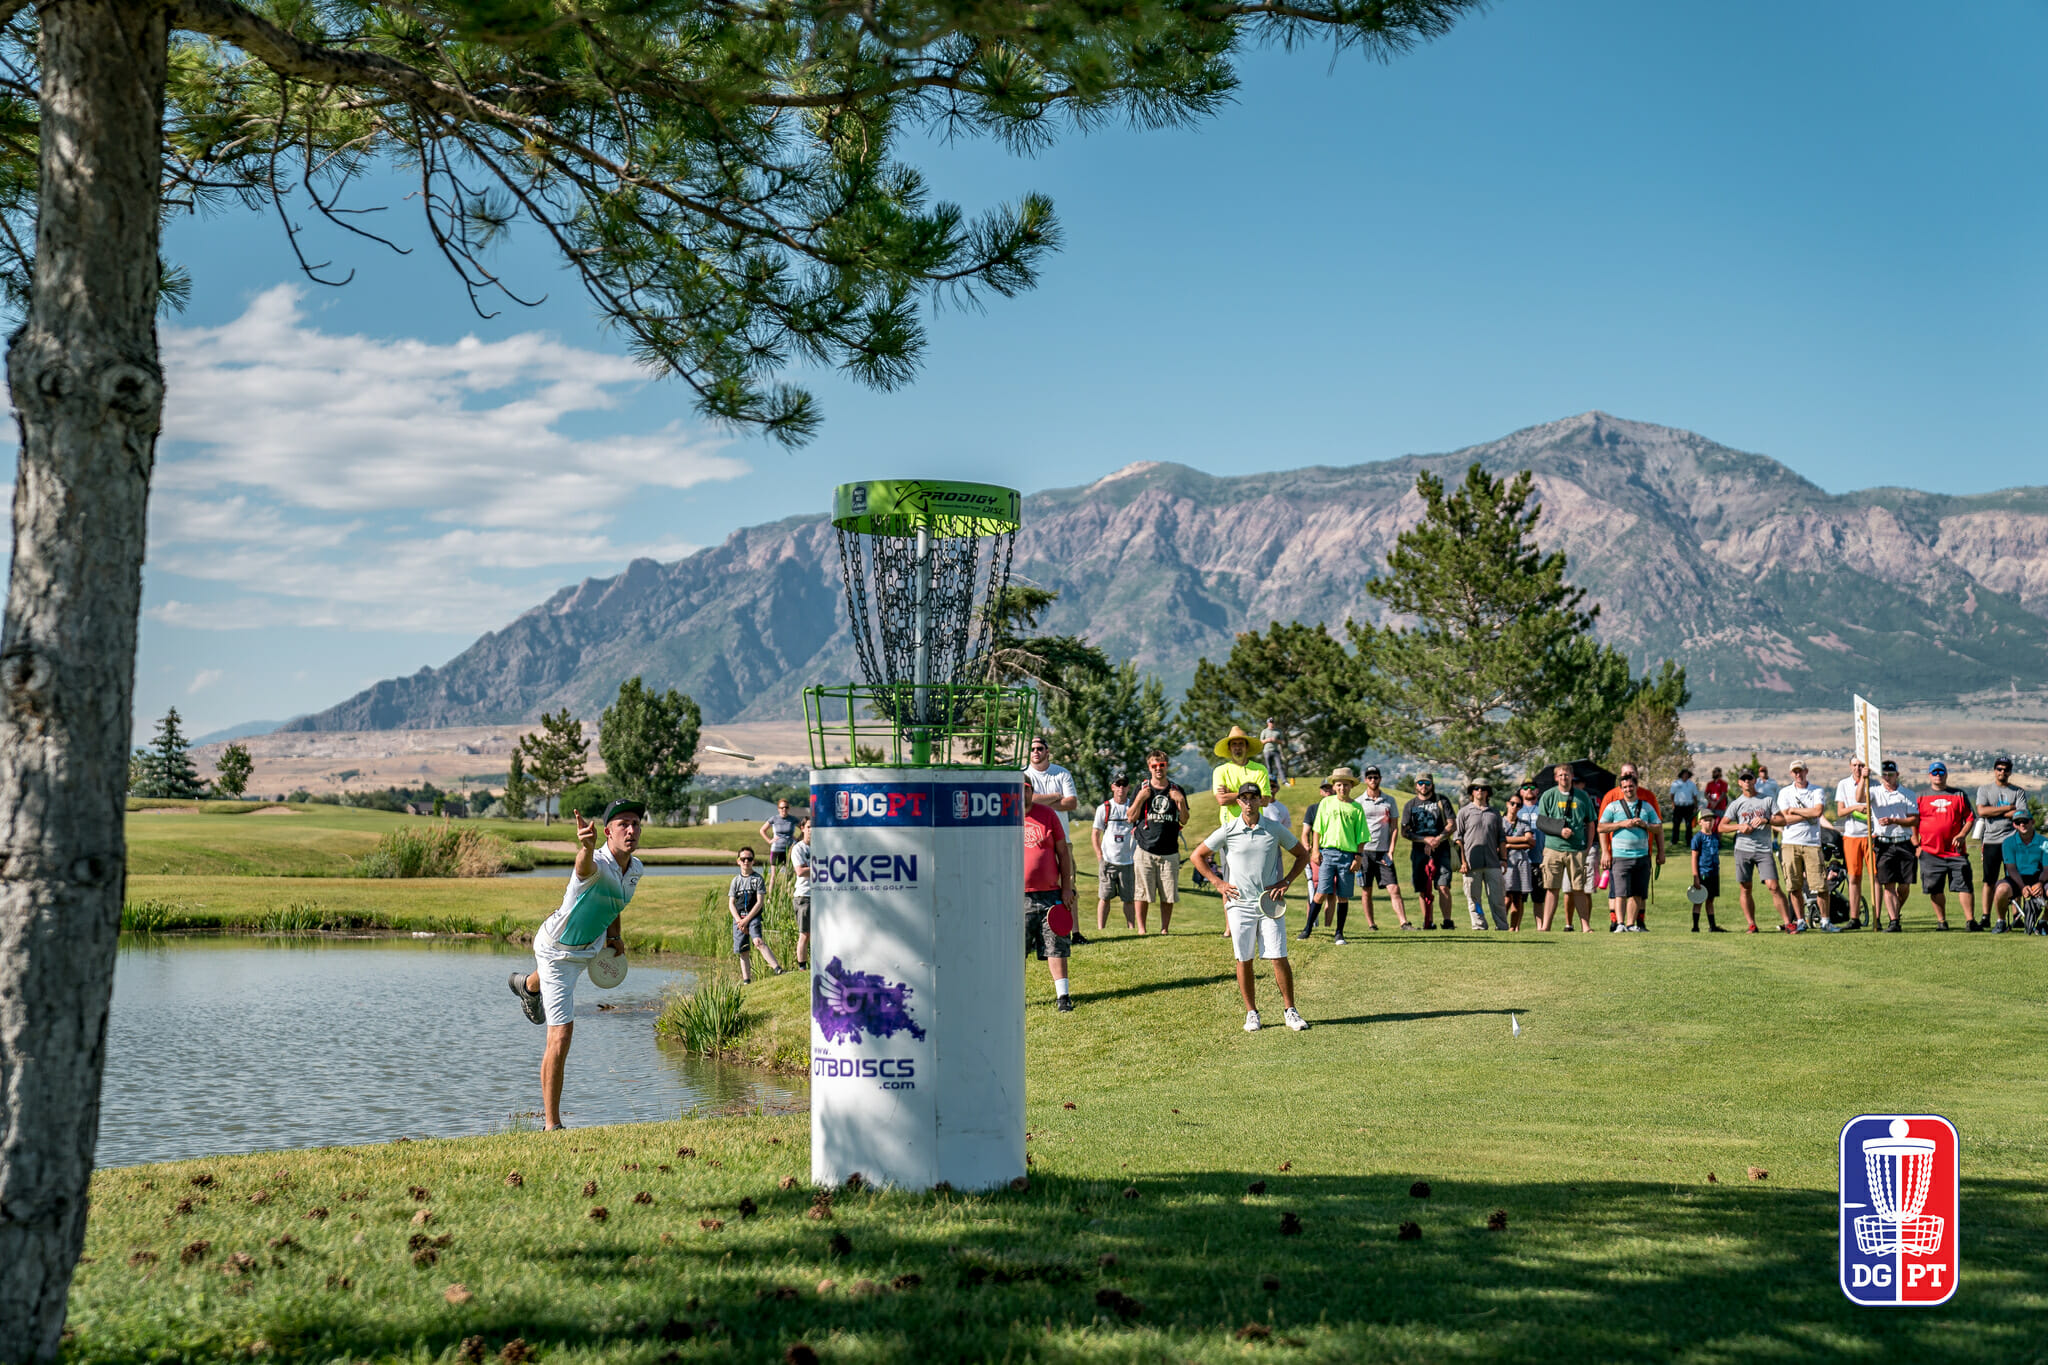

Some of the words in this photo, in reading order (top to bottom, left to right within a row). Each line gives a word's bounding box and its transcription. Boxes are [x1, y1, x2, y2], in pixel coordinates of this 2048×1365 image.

[918, 491, 998, 505] PRODIGY
[982, 505, 1005, 514] DISC
[850, 792, 926, 817] DGPT
[970, 792, 1020, 817] DGPT
[813, 1057, 915, 1078] OTBDISCS
[878, 1080, 916, 1090] .com
